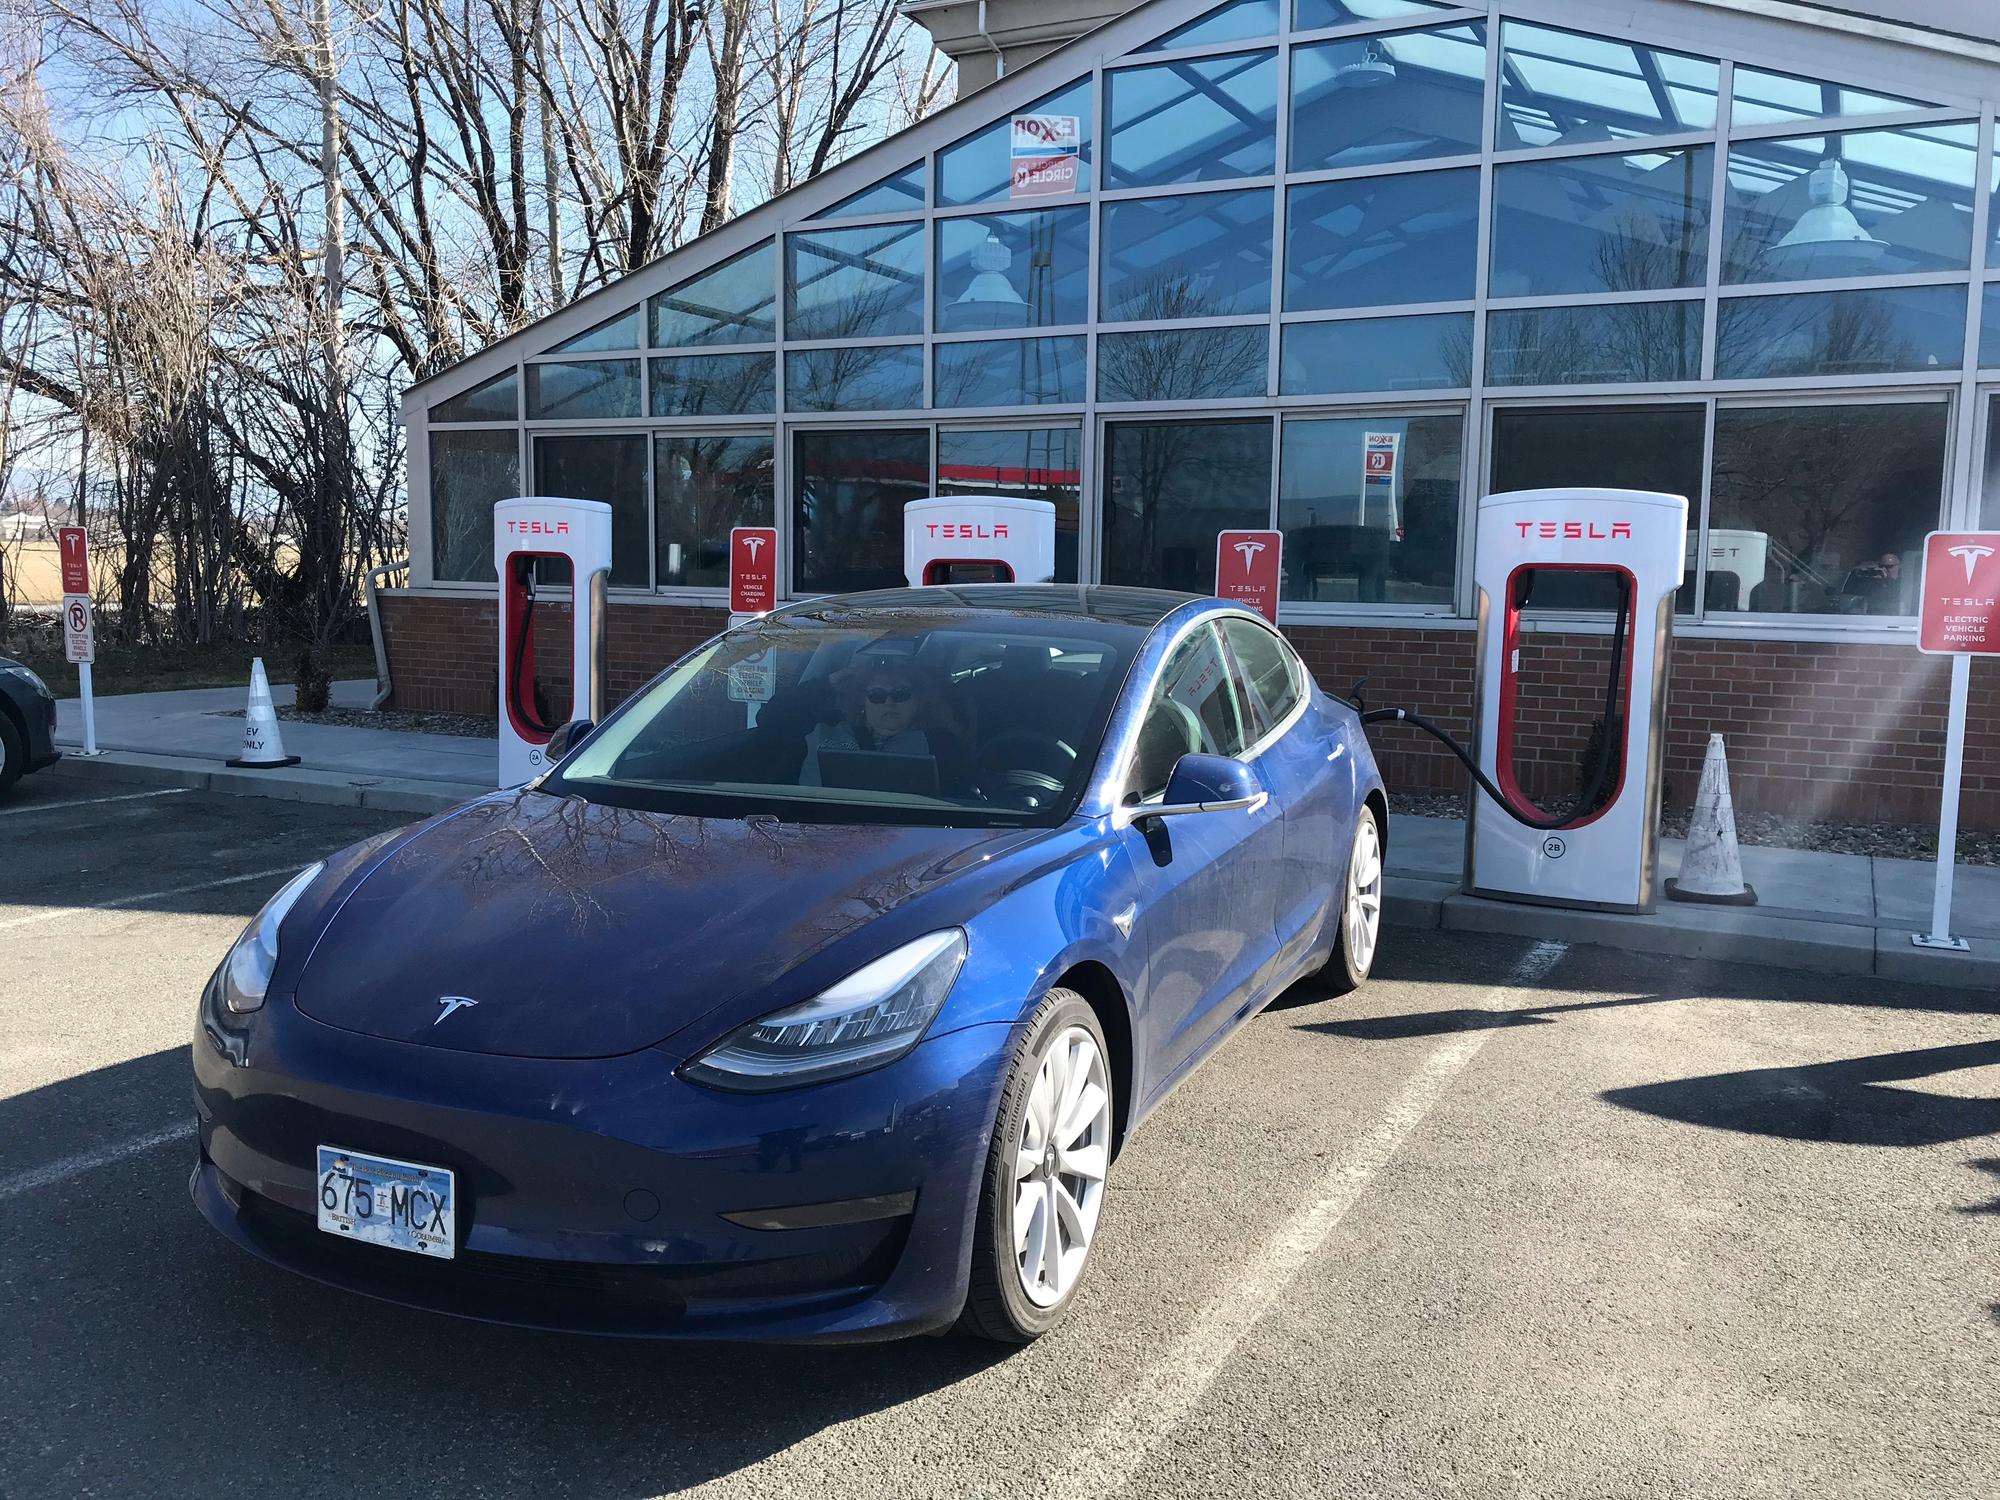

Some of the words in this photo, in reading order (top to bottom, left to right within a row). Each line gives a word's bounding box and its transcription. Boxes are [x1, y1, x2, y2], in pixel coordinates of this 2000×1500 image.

[507, 521, 569, 534] TESLA
[926, 524, 1009, 539] TESLA
[1515, 522, 1632, 539] TESLA
[740, 573, 767, 581] TESLA
[1229, 585, 1266, 593] TESLA
[1941, 597, 1995, 606] TESLA
[1943, 615, 1989, 624] ELECTRIC
[1945, 625, 1985, 633] VEHICLE
[1943, 634, 1986, 642] PARKING
[246, 727, 259, 736] EV
[1547, 843, 1561, 852] 2B
[1007, 1078, 1027, 1143] Continental
[321, 1172, 373, 1219] 675
[391, 1185, 447, 1236] MCX
